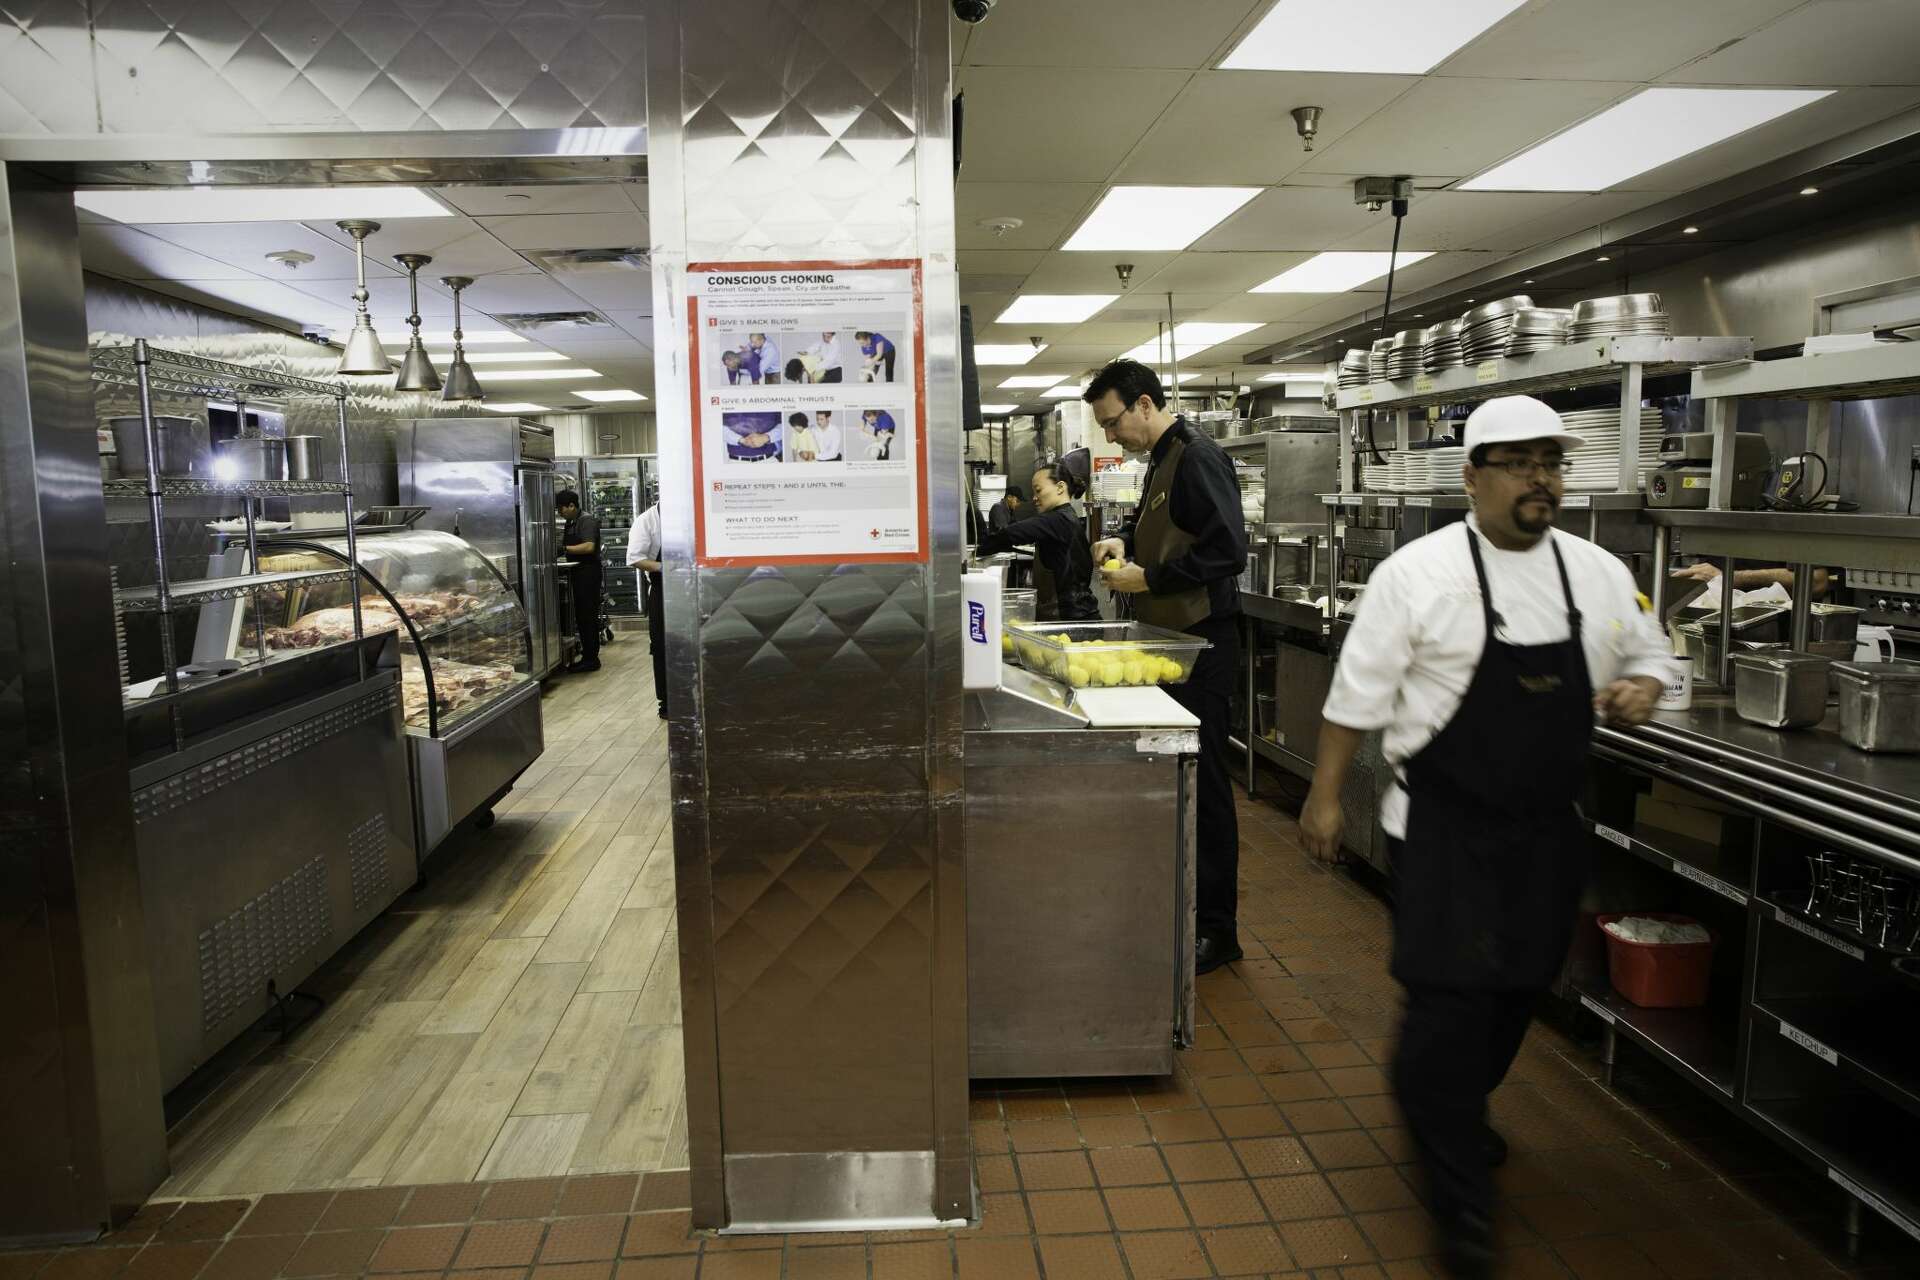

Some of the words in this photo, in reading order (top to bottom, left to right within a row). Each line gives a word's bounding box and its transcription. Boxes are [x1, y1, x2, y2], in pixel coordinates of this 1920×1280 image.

[708, 276, 776, 285] CONSCIOUS
[781, 275, 834, 284] CHOKING
[972, 606, 983, 640] Purell
[1791, 1031, 1829, 1057] KETCHUP
